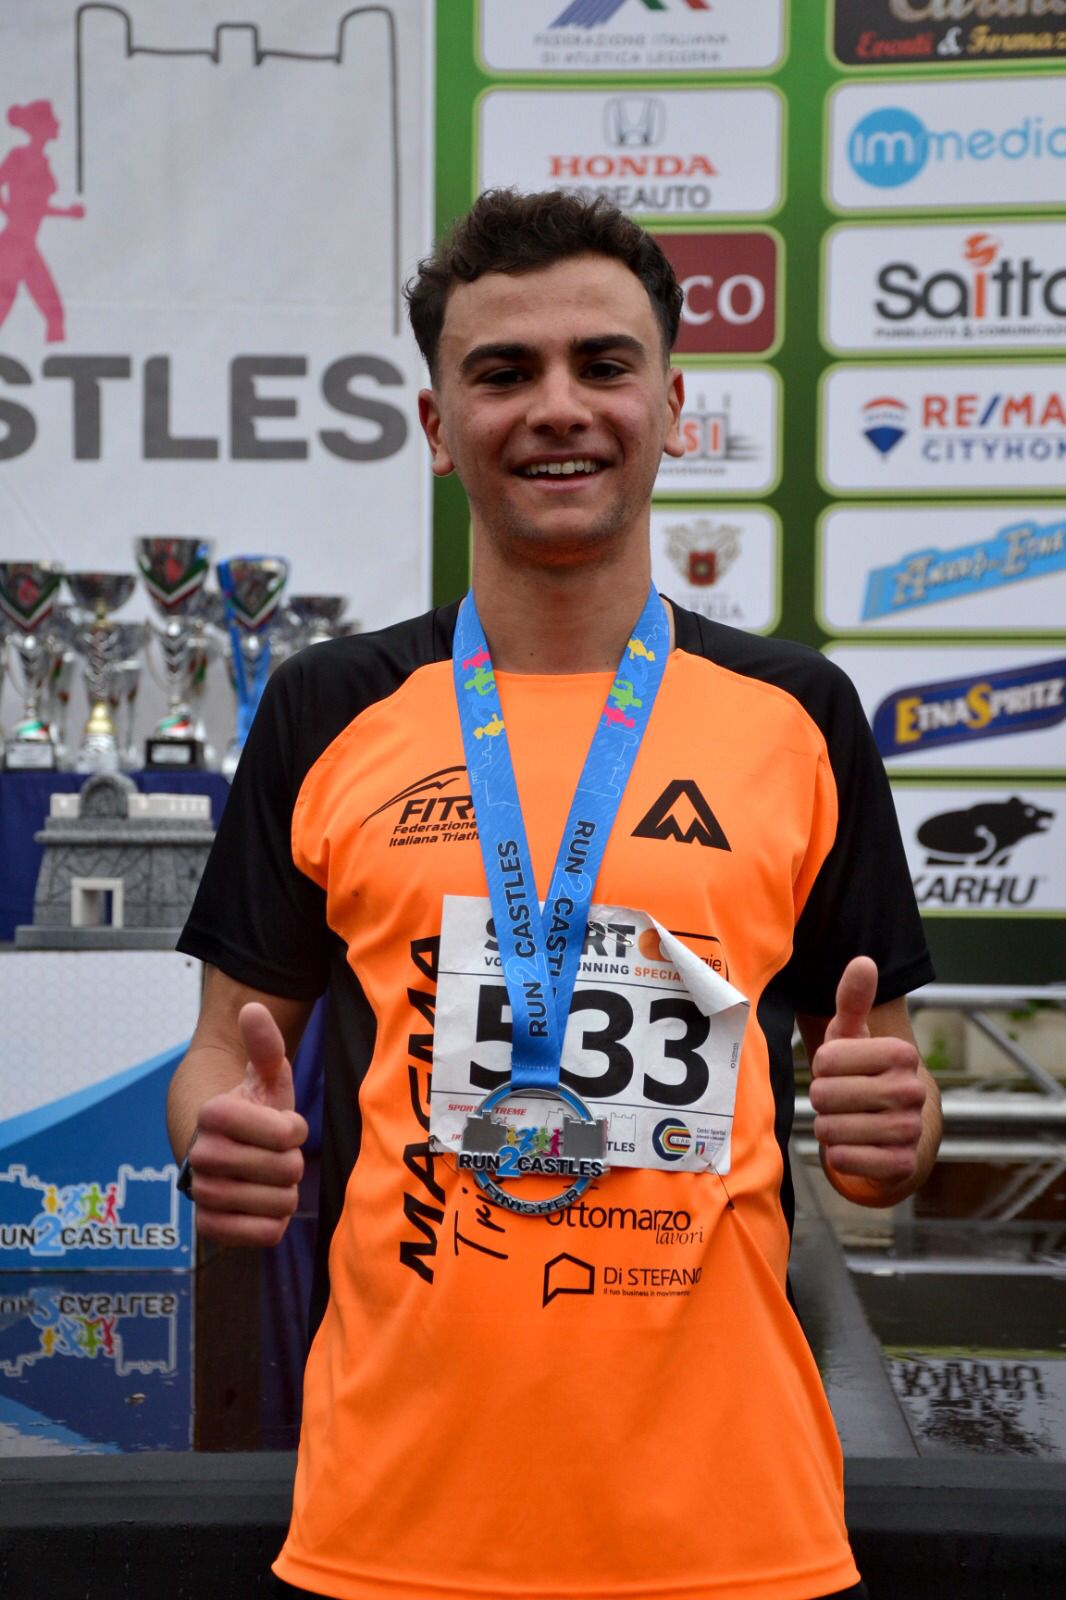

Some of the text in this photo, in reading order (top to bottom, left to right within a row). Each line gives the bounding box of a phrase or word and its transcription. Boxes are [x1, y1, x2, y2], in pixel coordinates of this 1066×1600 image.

[549, 154, 718, 178] HONDA
[398, 795, 477, 825] FITR
[392, 820, 479, 835] Federazione
[388, 831, 480, 848] Italiana Triath
[577, 961, 681, 982] NNING SPECIA
[470, 984, 710, 1107] 533
[483, 1183, 580, 1214] FINISHER
[454, 1184, 508, 1260] Tri
[544, 1200, 692, 1232] ottomarzo
[654, 1225, 704, 1245] lavori
[603, 1266, 623, 1285] Di
[622, 1288, 649, 1297] business
